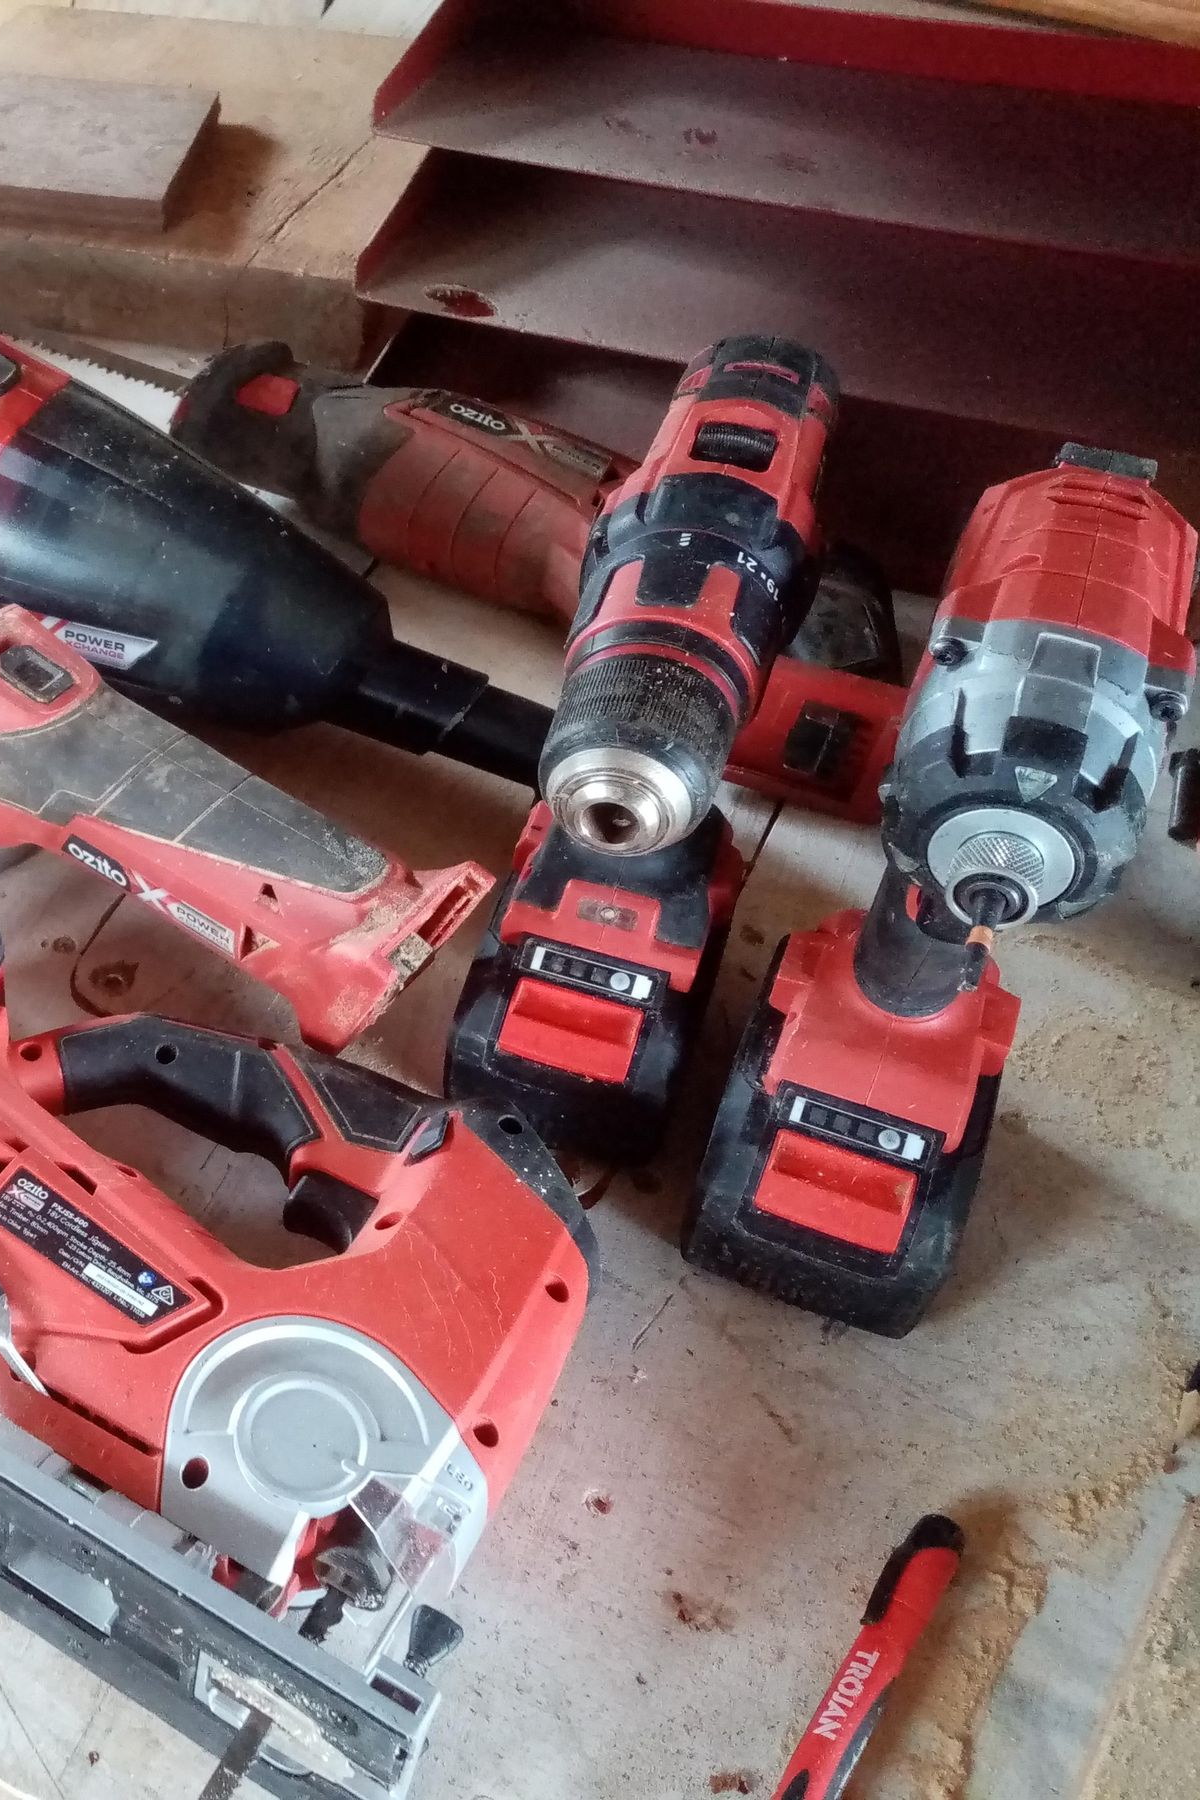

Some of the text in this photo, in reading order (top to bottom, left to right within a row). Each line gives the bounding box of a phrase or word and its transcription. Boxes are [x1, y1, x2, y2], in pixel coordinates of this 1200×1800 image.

[450, 403, 507, 431] ozito
[737, 551, 758, 573] 21
[64, 630, 126, 653] POWER
[64, 639, 125, 660] XCHANGE
[67, 843, 128, 887] ozito
[176, 906, 231, 945] POWER
[17, 1178, 49, 1200] ozito
[60, 1217, 89, 1238] Cordless
[811, 1648, 881, 1741] TROJAN
